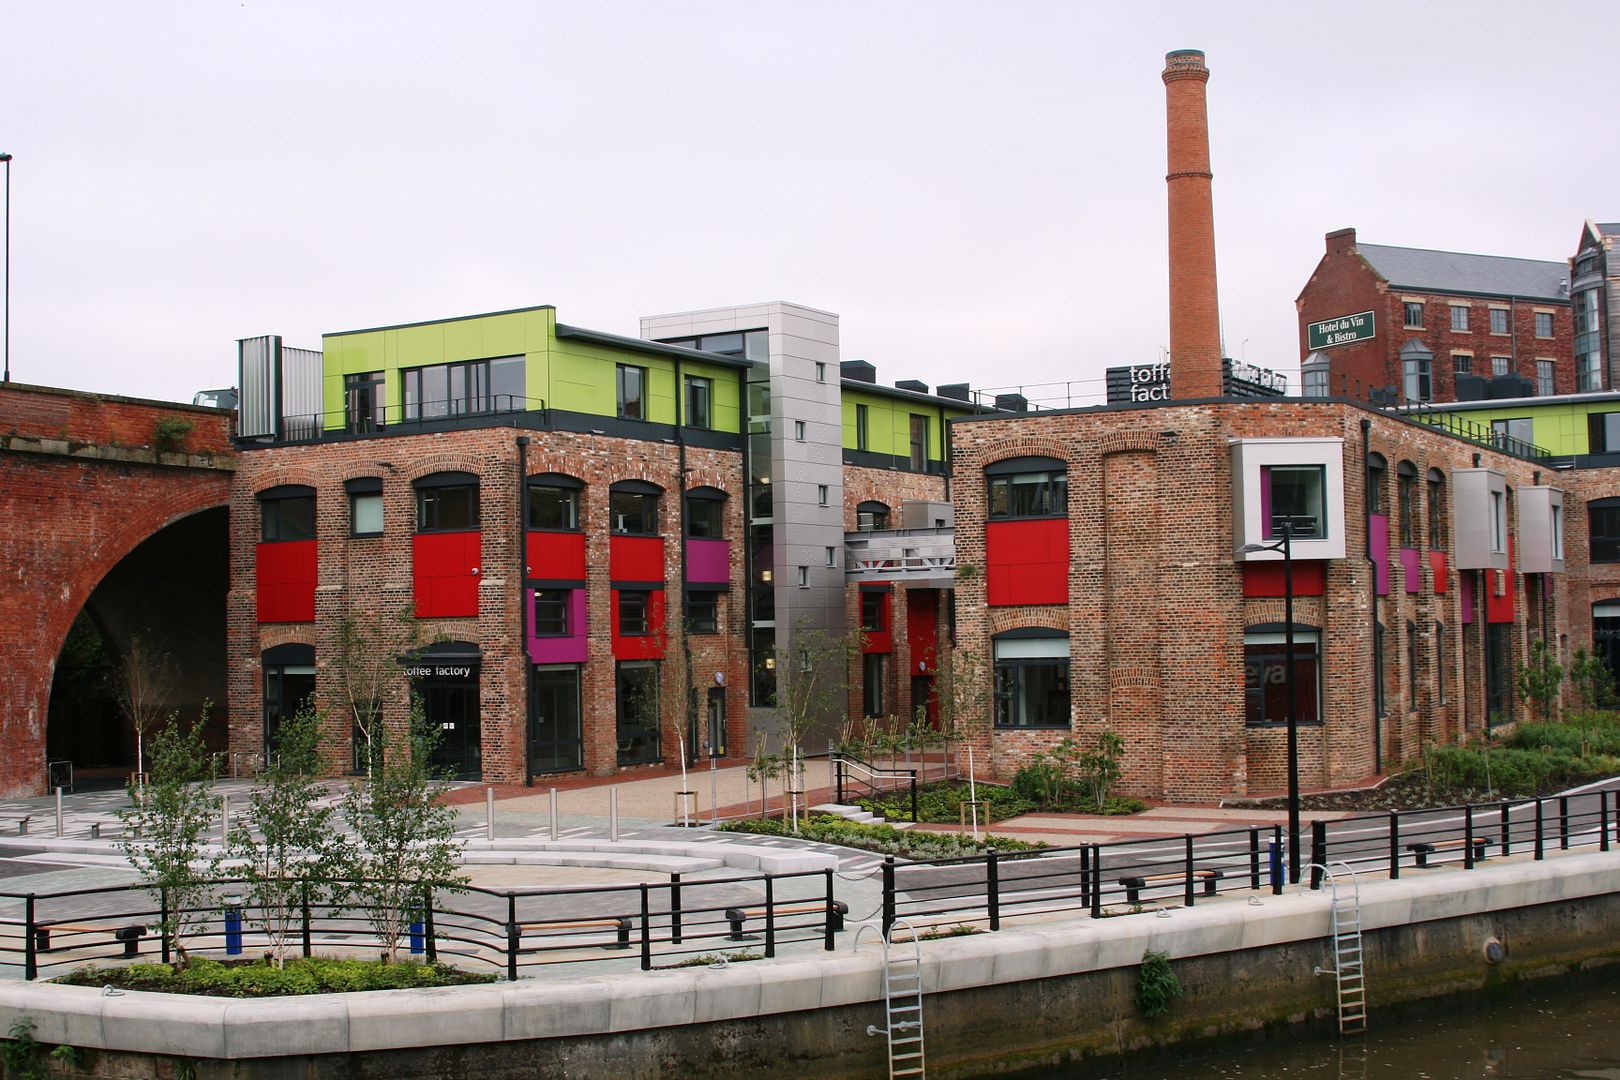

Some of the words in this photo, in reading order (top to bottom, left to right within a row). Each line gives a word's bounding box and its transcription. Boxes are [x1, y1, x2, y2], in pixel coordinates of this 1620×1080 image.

[1319, 321, 1339, 334] Hotel
[1340, 319, 1350, 330] du
[1350, 316, 1364, 327] Vin
[1326, 334, 1333, 344] &
[1334, 331, 1357, 343] Bistro
[1129, 363, 1171, 383] toff
[1130, 383, 1171, 402] fact
[403, 665, 432, 676] toffee
[435, 665, 470, 678] factory
